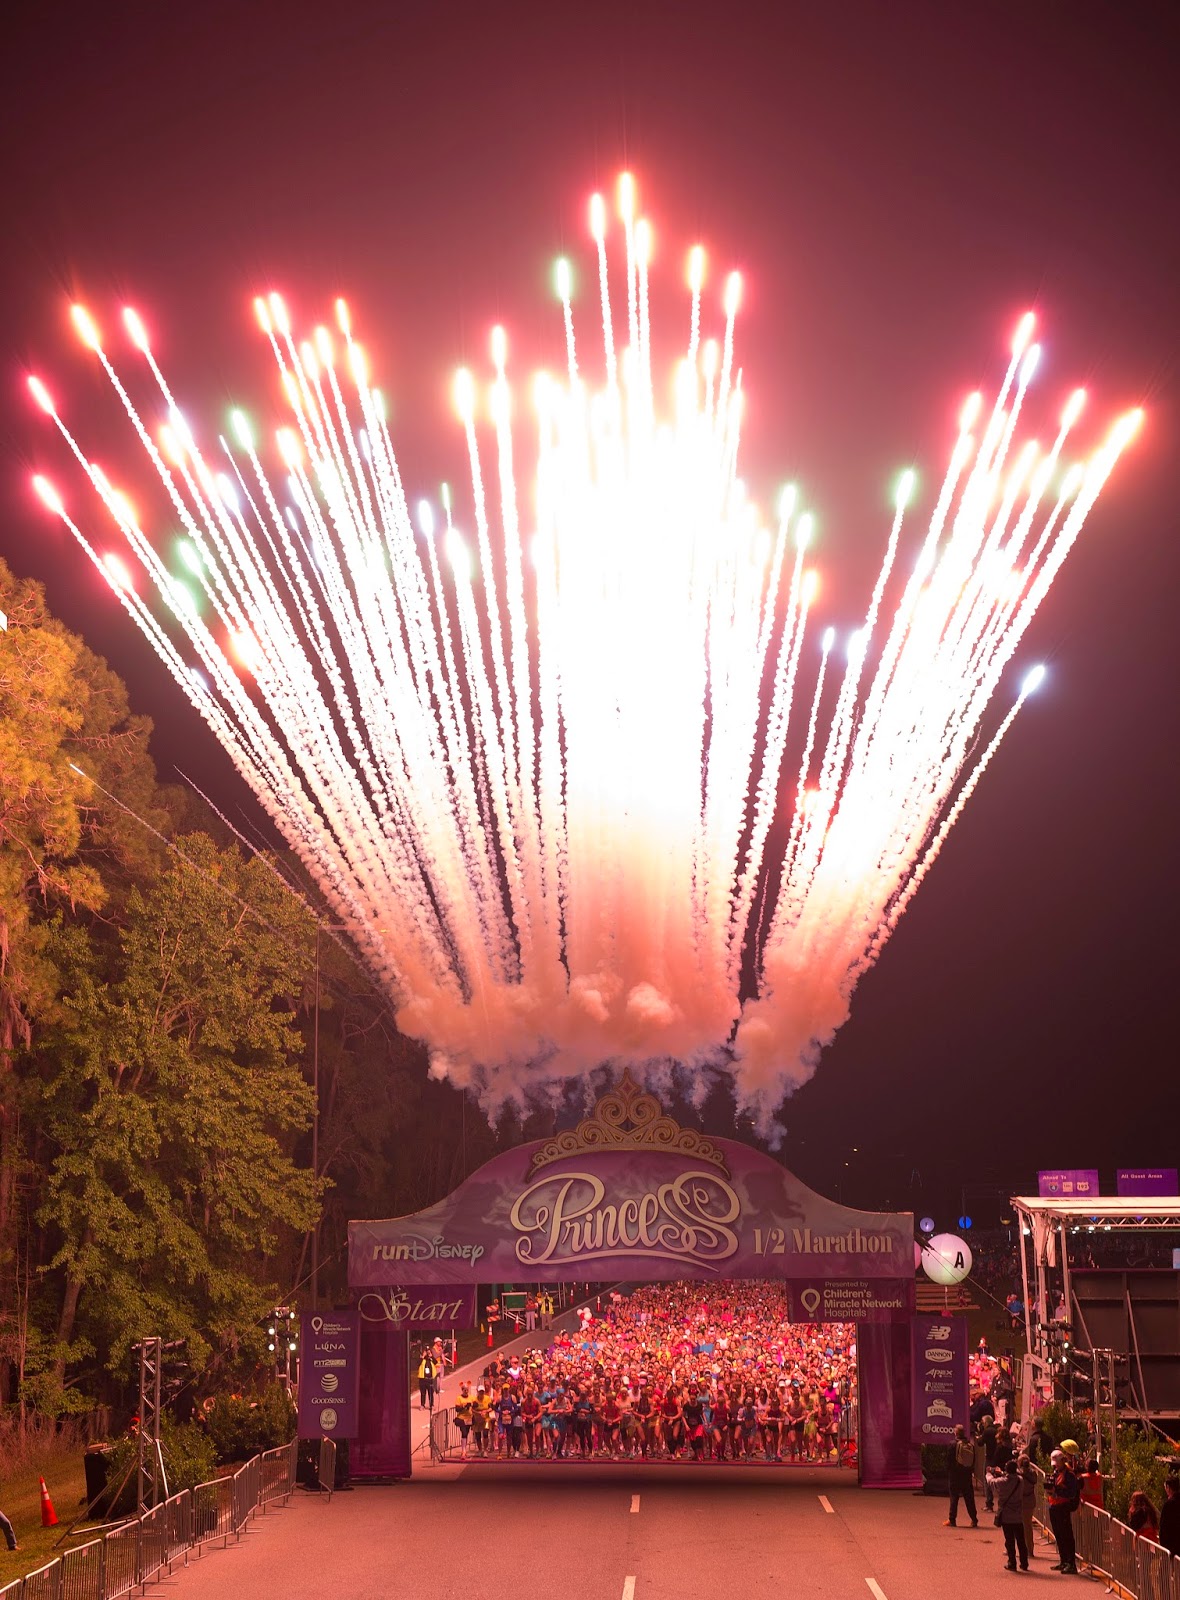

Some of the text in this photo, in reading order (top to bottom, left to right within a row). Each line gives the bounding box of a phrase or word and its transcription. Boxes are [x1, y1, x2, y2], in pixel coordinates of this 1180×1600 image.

[510, 1171, 740, 1272] Princess
[753, 1227, 893, 1257] 1/2 Marathon
[954, 1251, 964, 1269] A
[823, 1289, 872, 1298] Children's
[358, 1285, 464, 1322] Start
[824, 1299, 903, 1308] Miracle Network
[824, 1308, 867, 1318] Hospitals
[314, 1341, 346, 1352] LUNA
